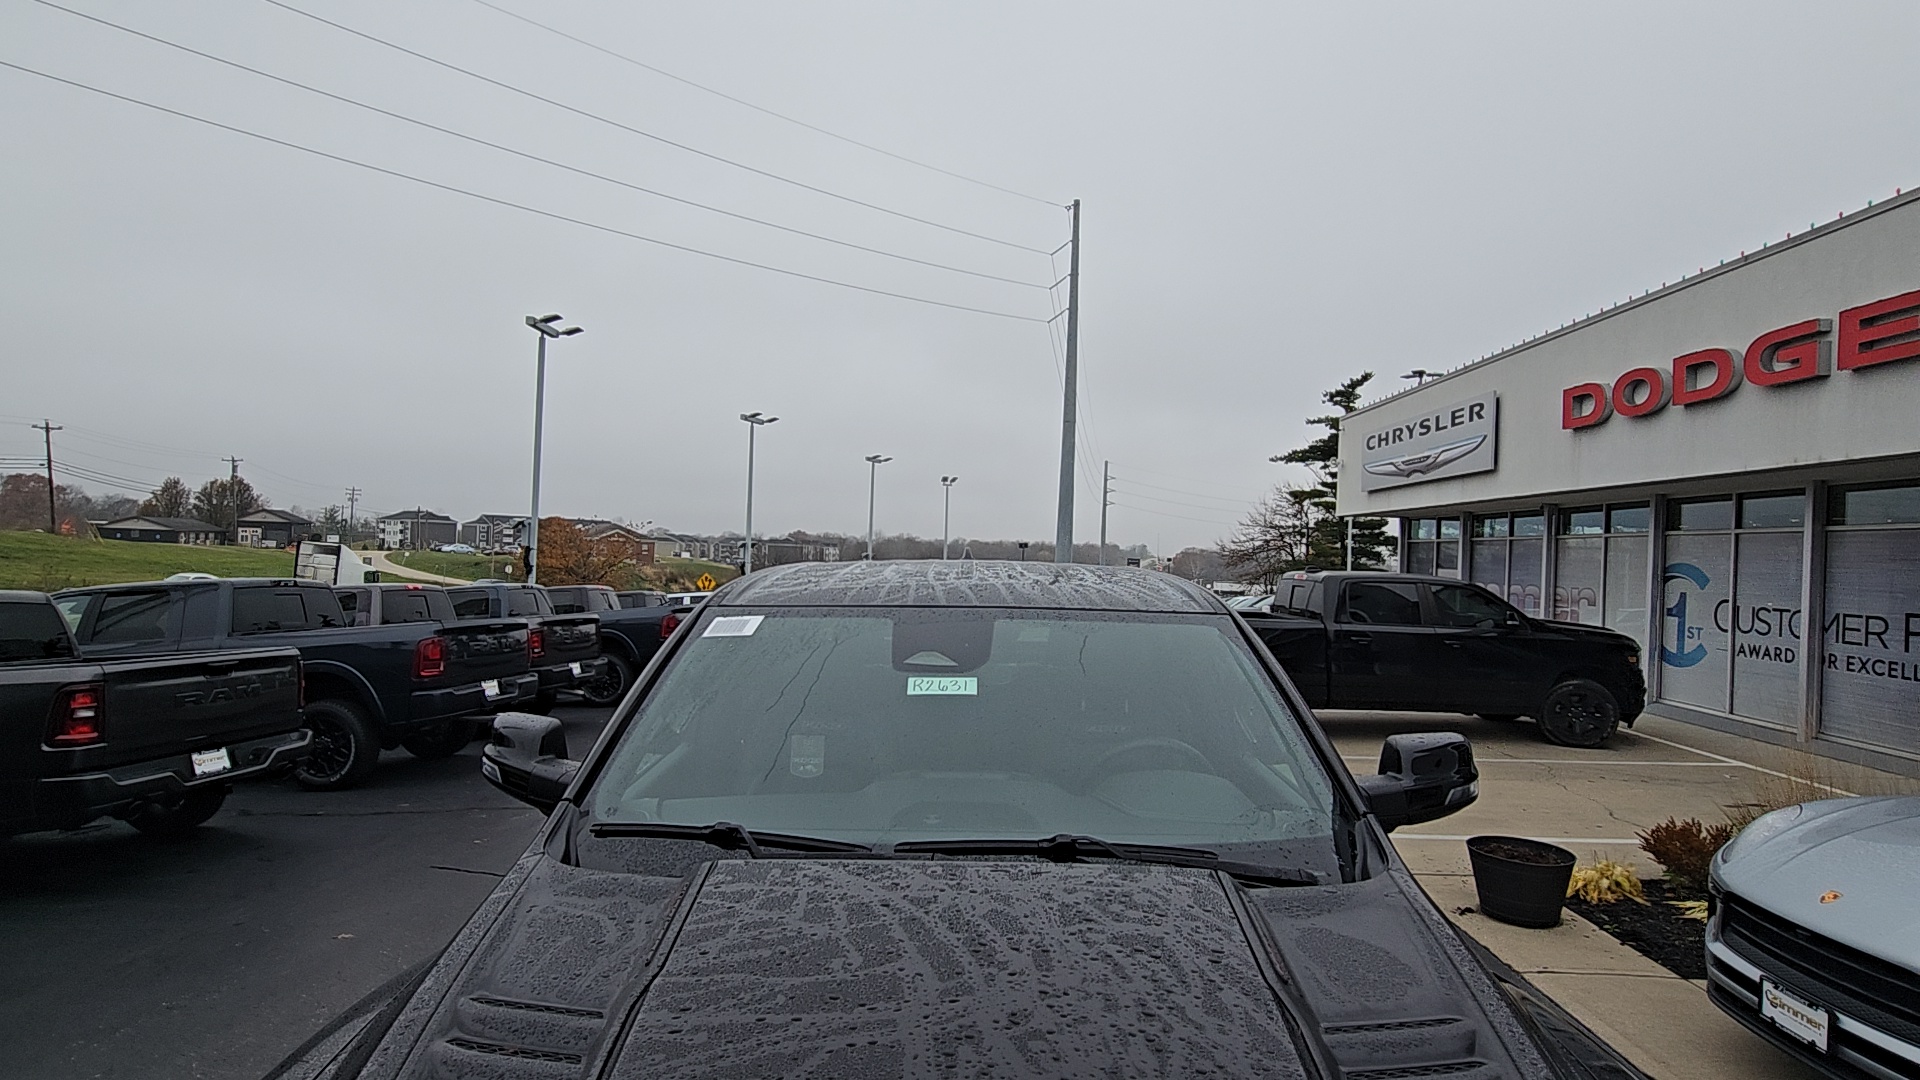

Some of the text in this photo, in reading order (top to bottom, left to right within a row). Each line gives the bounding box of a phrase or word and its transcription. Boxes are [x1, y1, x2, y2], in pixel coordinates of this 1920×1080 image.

[1562, 289, 1920, 429] DODGE
[1366, 402, 1485, 450] CHRYSLER
[1736, 643, 1796, 664] AWARD
[912, 678, 968, 692] R2631
